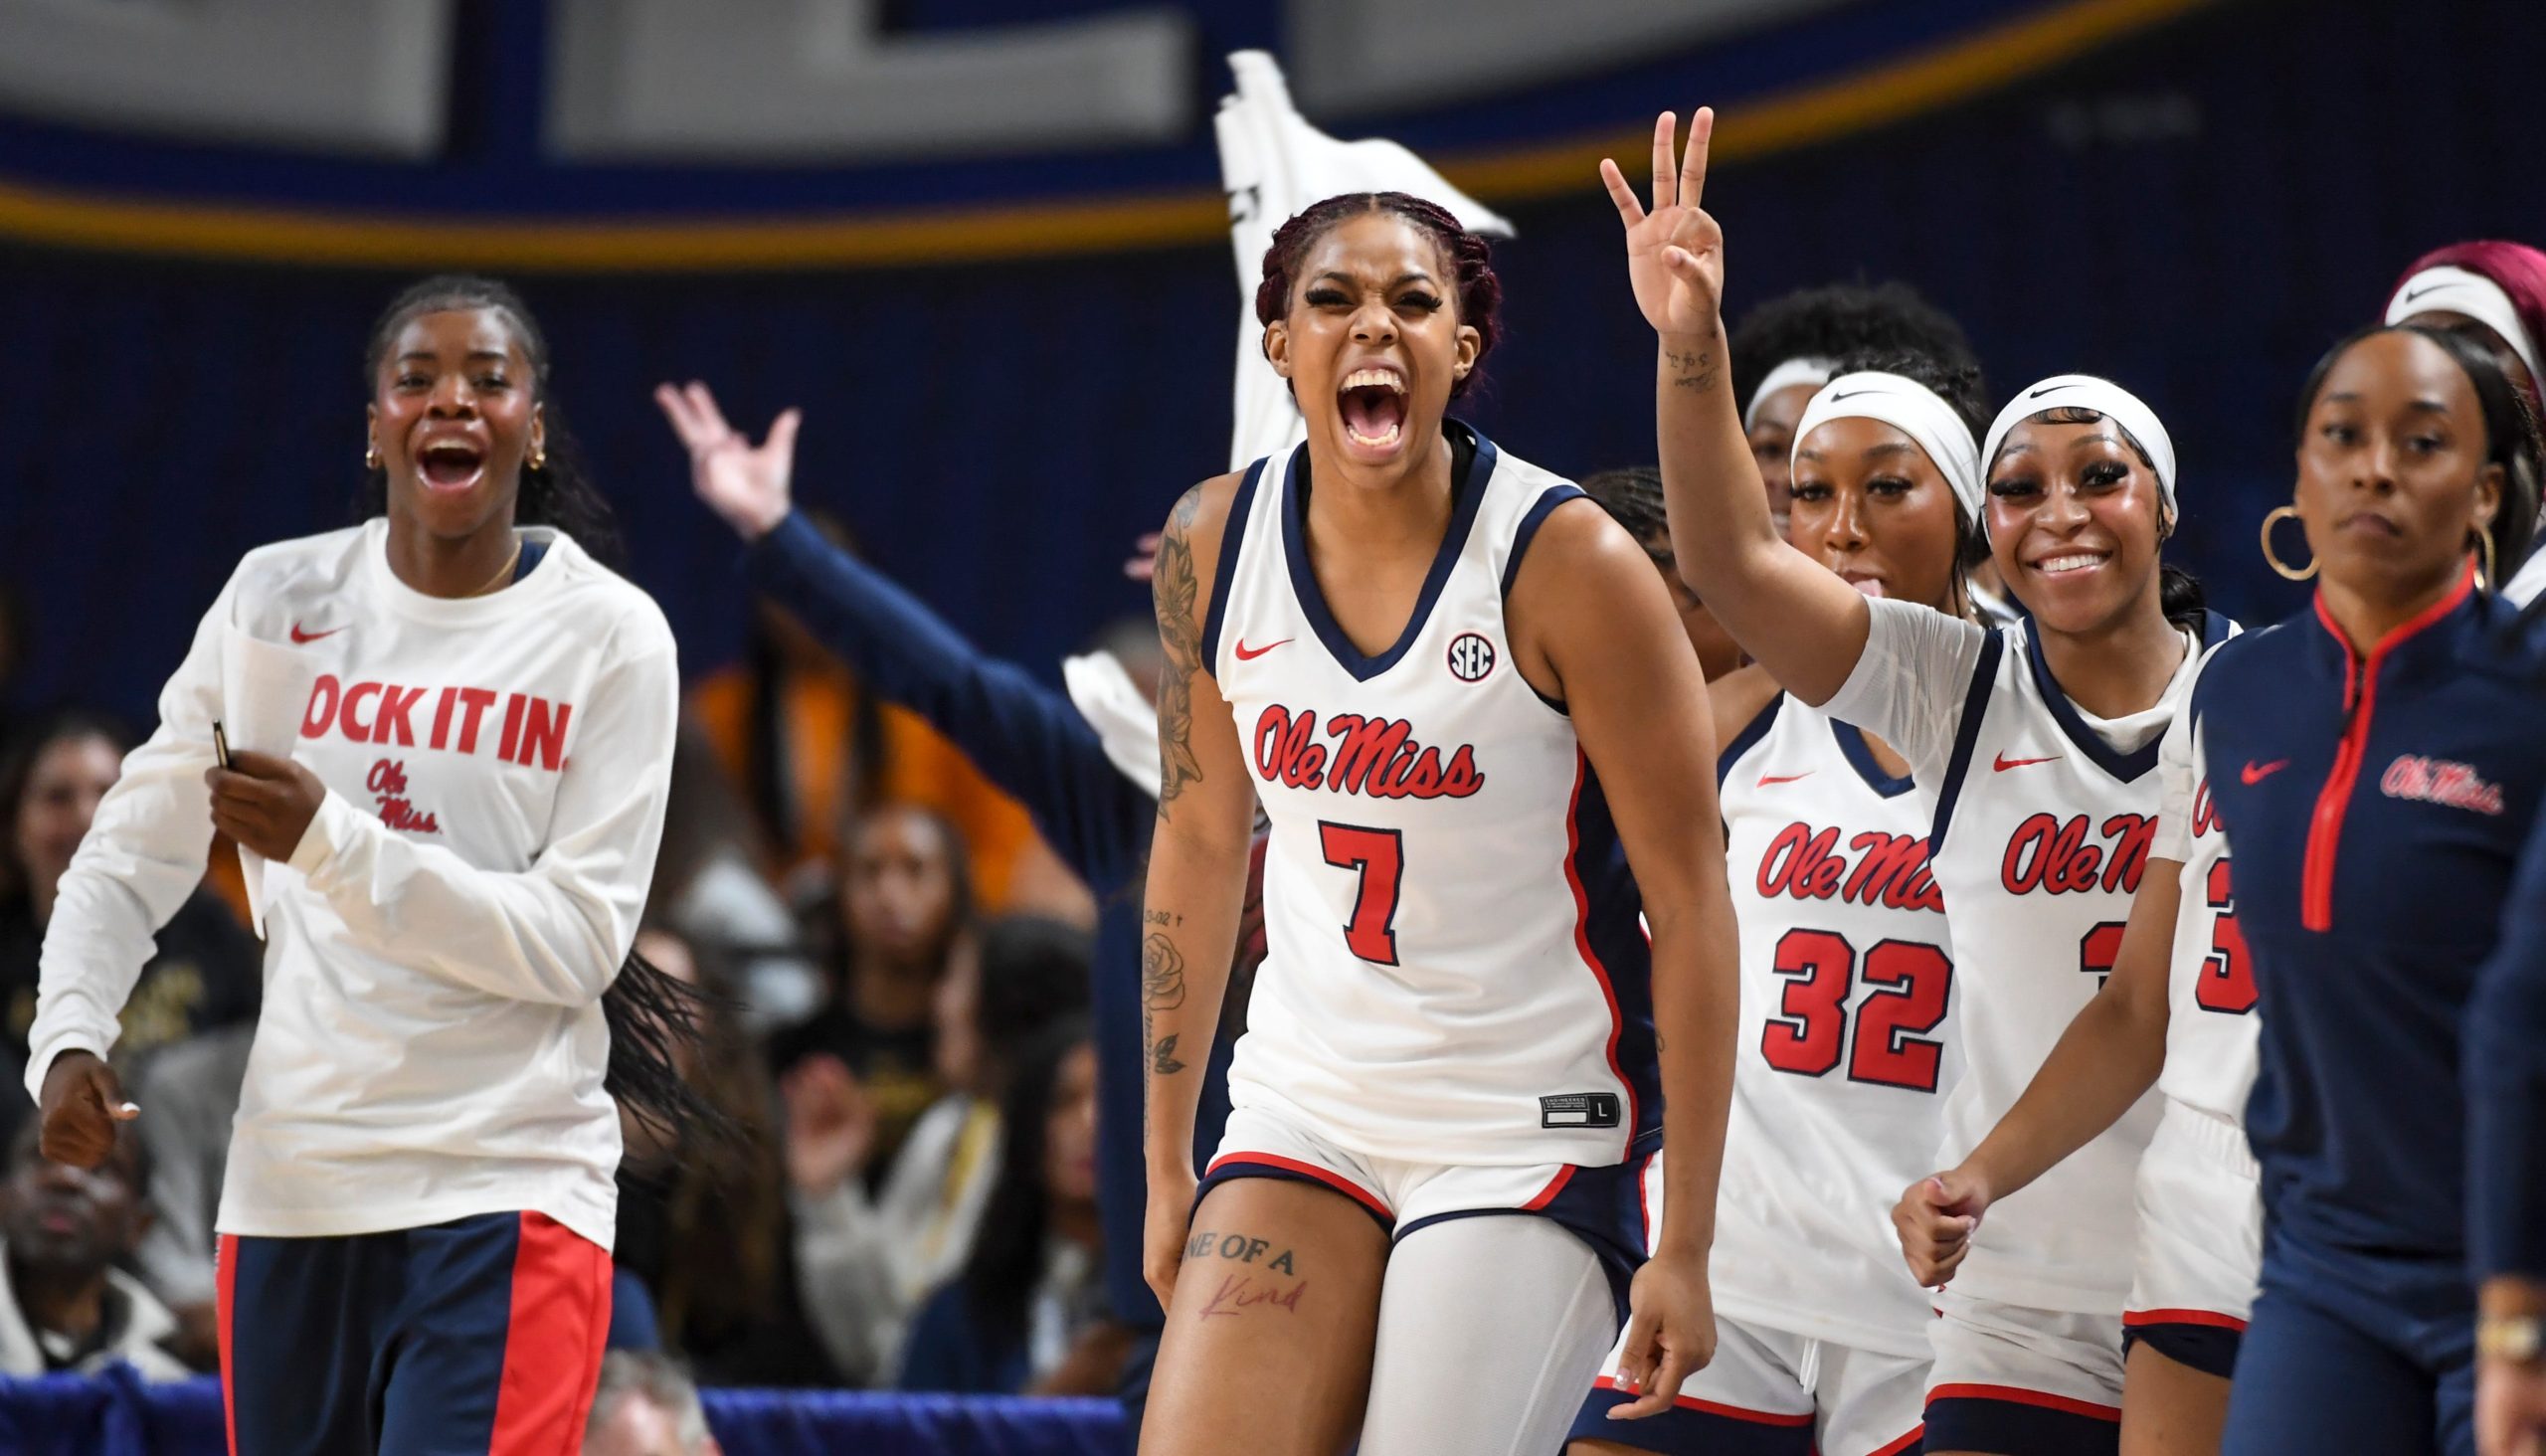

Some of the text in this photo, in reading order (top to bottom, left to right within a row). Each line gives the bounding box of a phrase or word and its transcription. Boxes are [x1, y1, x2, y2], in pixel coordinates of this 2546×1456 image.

[1450, 636, 1492, 679] SEC
[299, 674, 428, 748] OCK
[430, 686, 497, 755] IT
[1254, 703, 1486, 800] Ole Miss
[366, 758, 439, 834] Ole Miss
[2380, 754, 2505, 817] Ole Miss
[1755, 821, 1946, 913] Ole Mi
[2001, 812, 2103, 896] Ole
[1317, 819, 1404, 968] 7
[1760, 927, 1954, 1095] 32
[1597, 1102, 1608, 1117] L
[1184, 1232, 1295, 1276] NE OF A
[1198, 1274, 1308, 1321] Kind
